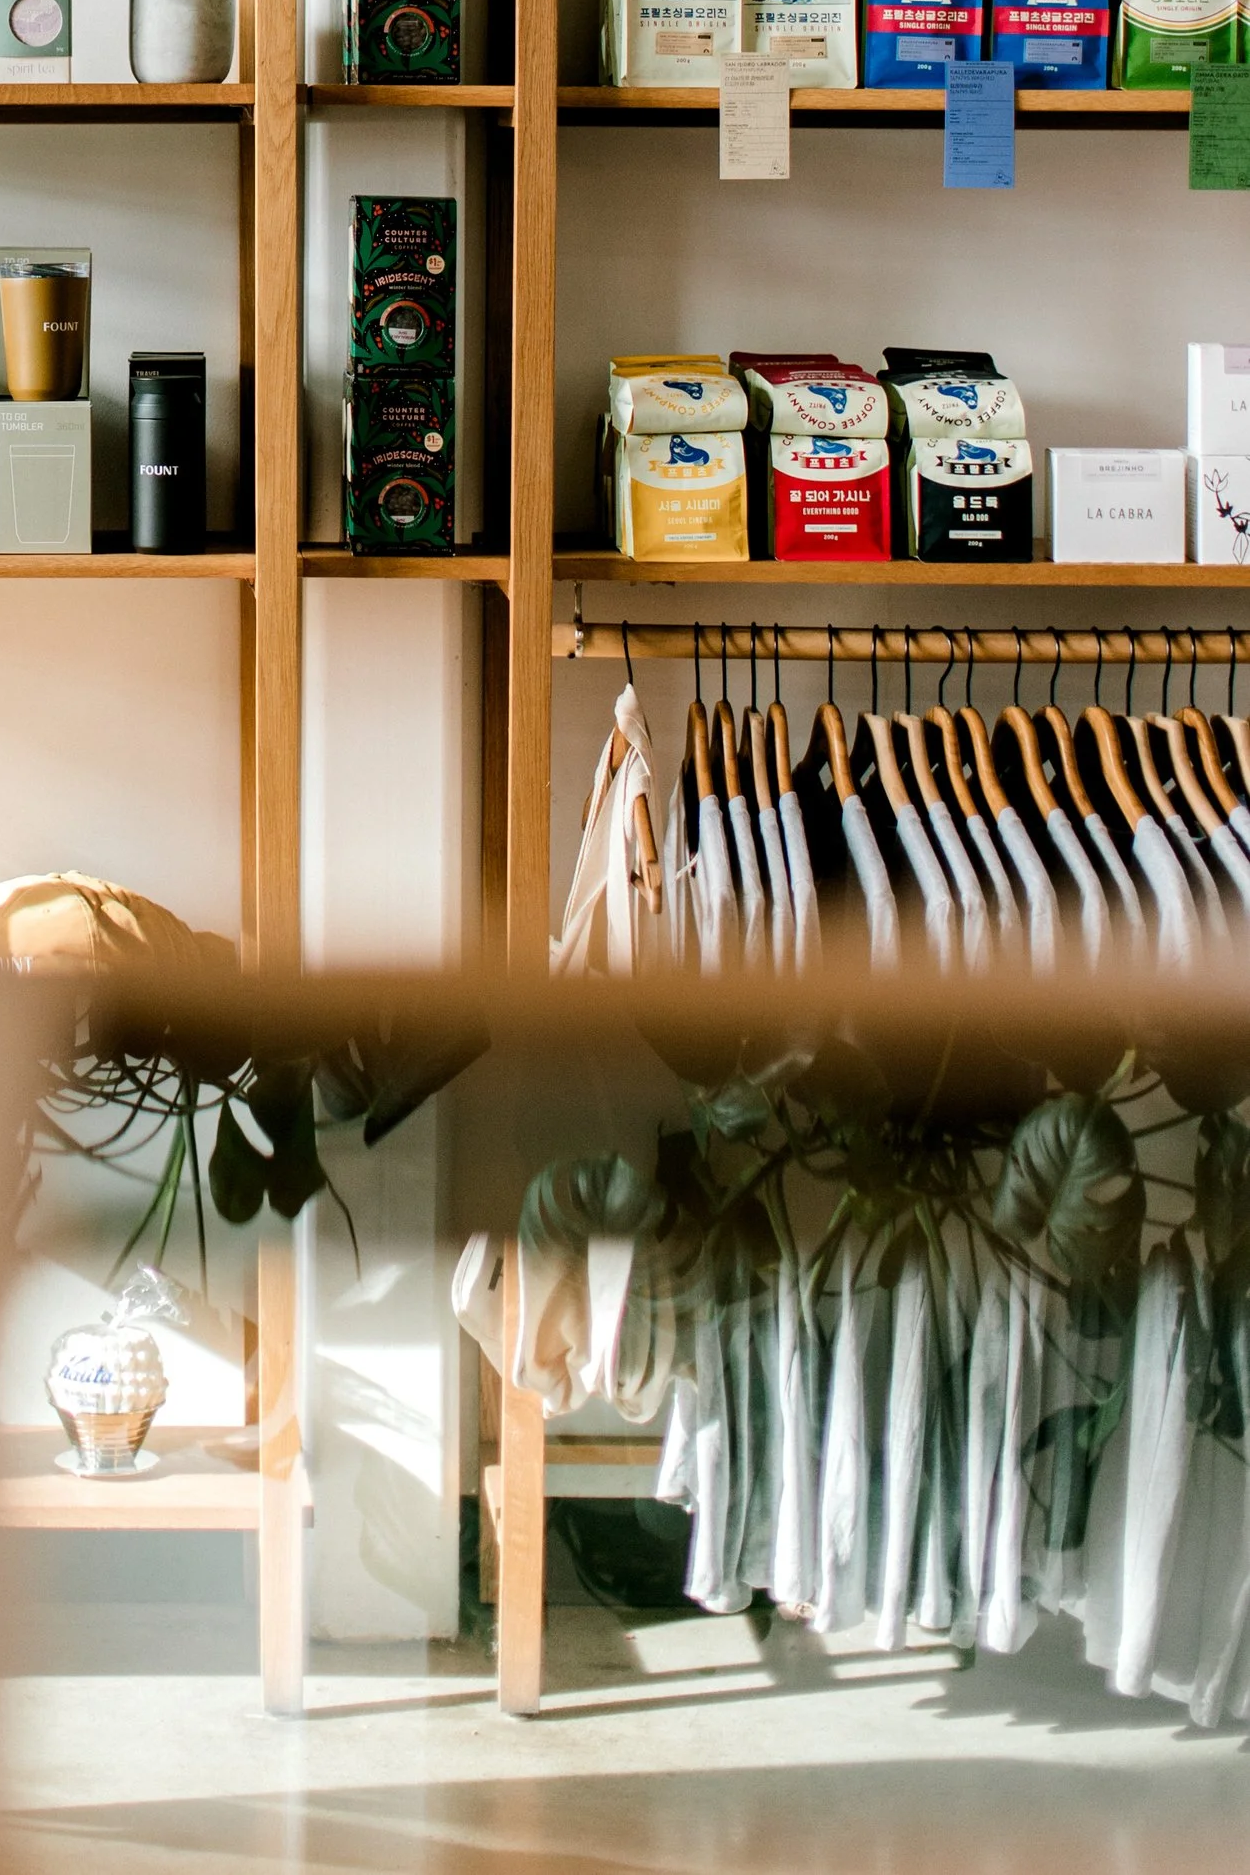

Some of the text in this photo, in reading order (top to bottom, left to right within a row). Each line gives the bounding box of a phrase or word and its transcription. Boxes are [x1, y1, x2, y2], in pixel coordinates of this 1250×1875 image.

[7, 63, 55, 76] spirit tea
[374, 273, 436, 287] IRIDESCENT
[43, 321, 79, 332] FOUNT
[787, 391, 876, 431] COFFEE COMPANY
[918, 390, 1006, 427] COFFEE COMPANY
[1231, 400, 1247, 411] LA
[1, 413, 27, 421] TO GO
[1, 422, 44, 431] TUMBLER
[373, 451, 434, 465] IRIDESCENT
[140, 465, 179, 476] FOUNT
[790, 490, 871, 502] 잘 되어 가시나
[659, 499, 721, 512] 서울 시네마
[803, 507, 859, 515] EVERYTHING GOOD
[962, 513, 975, 521] OLD
[1087, 508, 1153, 520] LA CABRA
